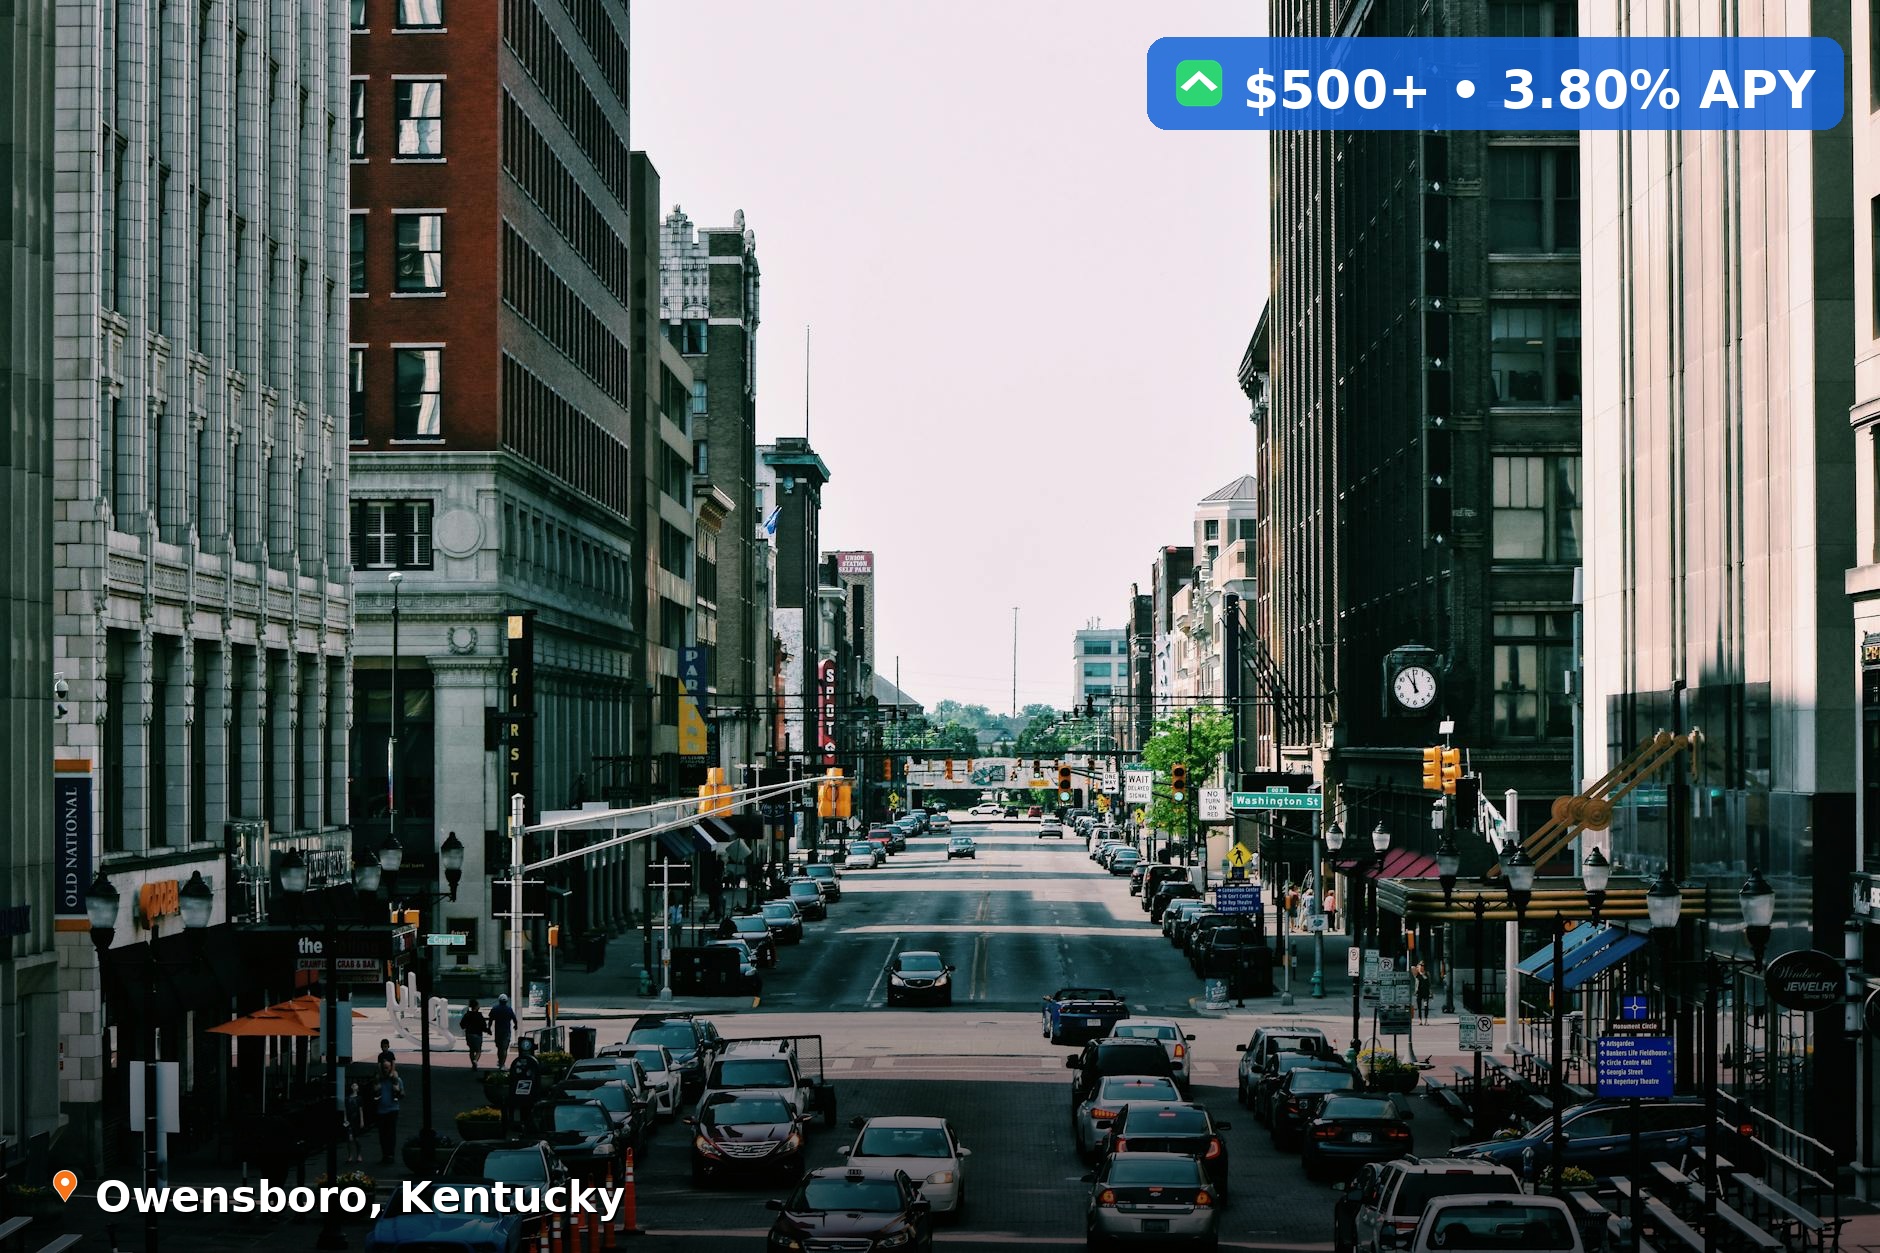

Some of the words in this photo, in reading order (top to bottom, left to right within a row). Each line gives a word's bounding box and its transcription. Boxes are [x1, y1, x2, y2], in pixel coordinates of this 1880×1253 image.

[1236, 796, 1302, 807] Washington
[1306, 797, 1318, 806] St
[66, 787, 78, 868] NATIONAL
[66, 872, 78, 907] OLD
[298, 937, 322, 954] the
[1784, 982, 1838, 991] JEWELRY
